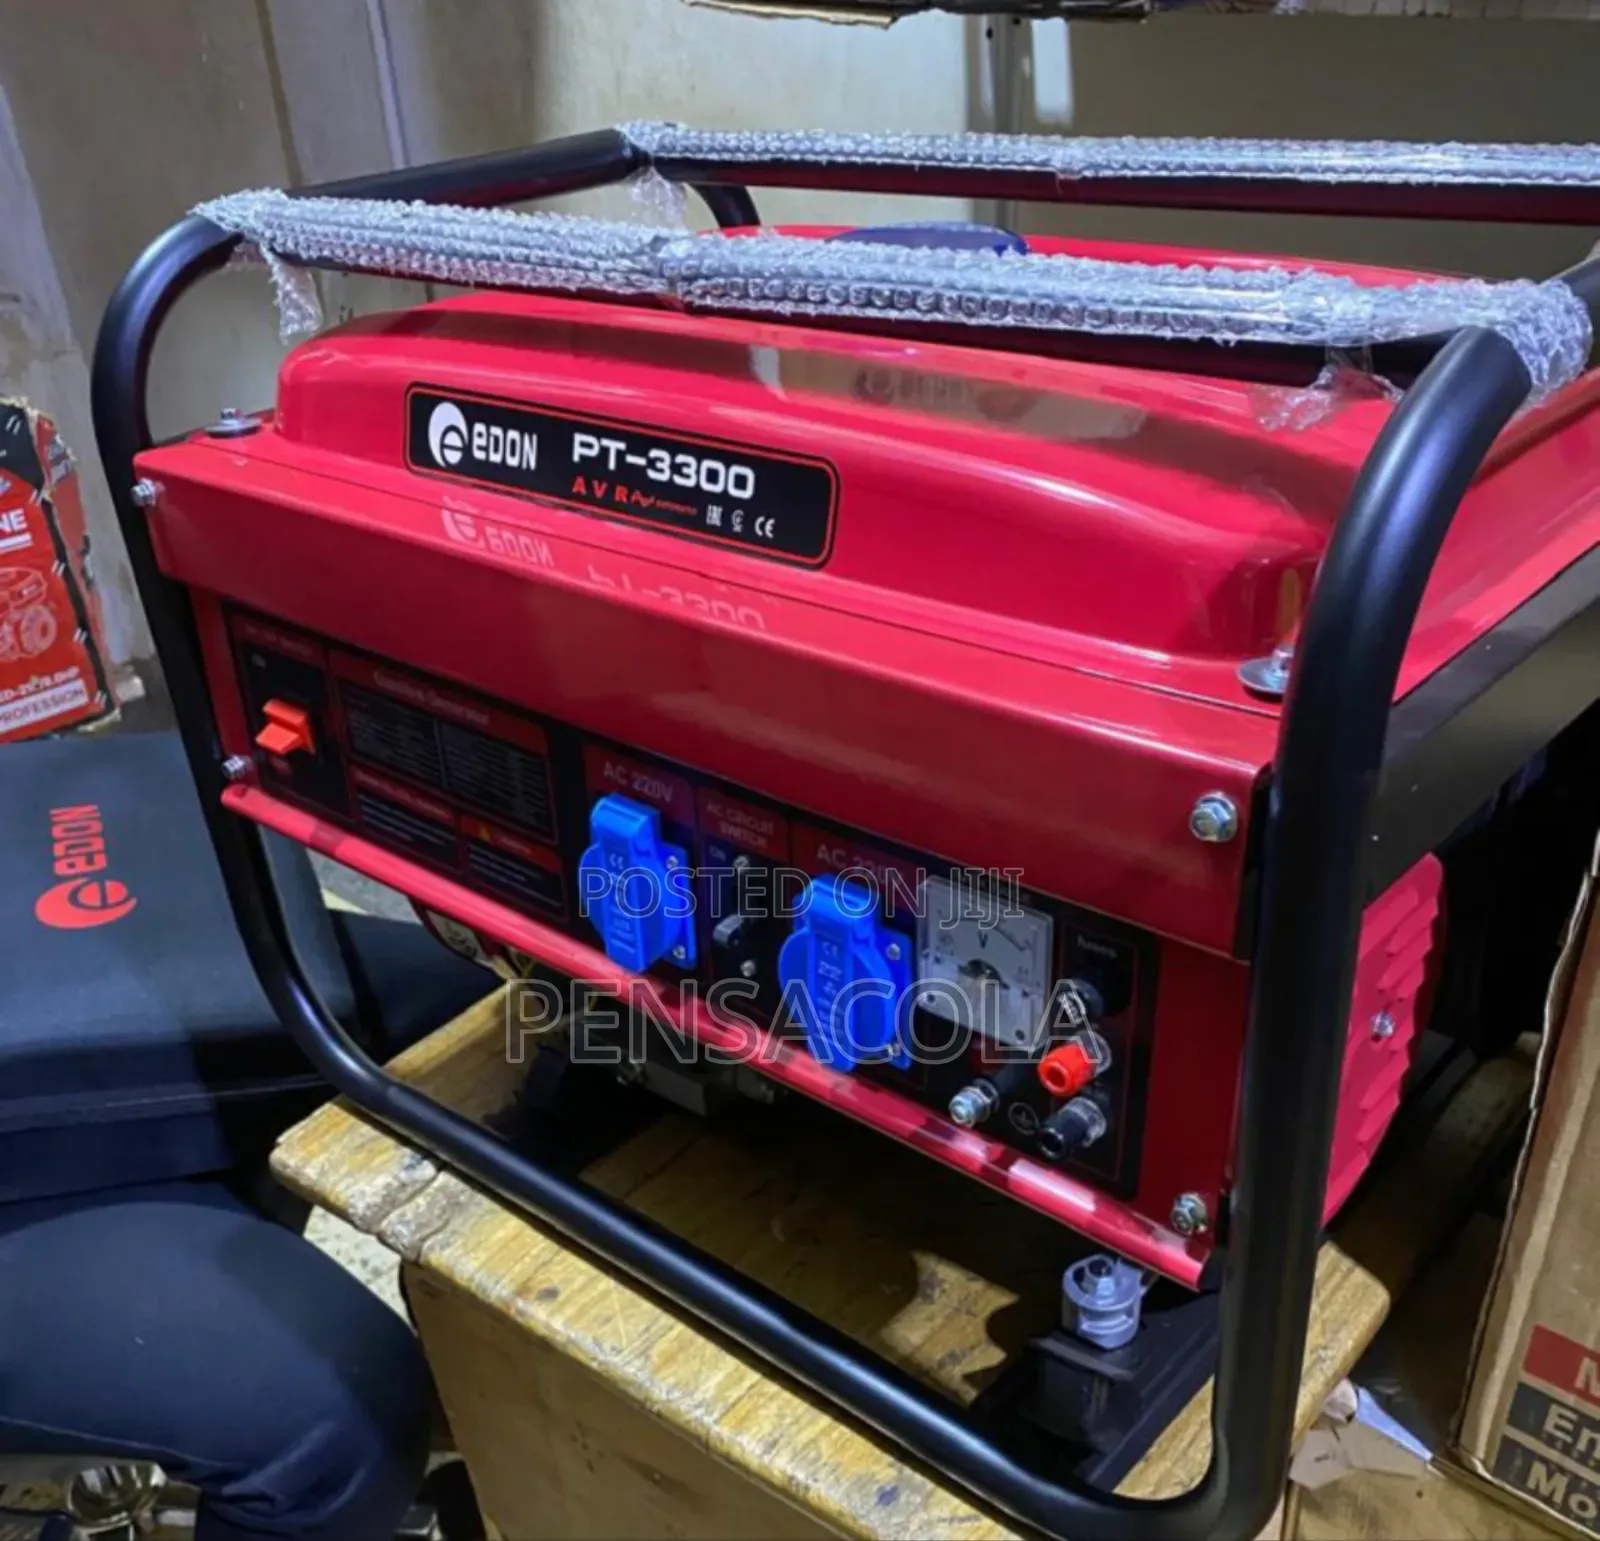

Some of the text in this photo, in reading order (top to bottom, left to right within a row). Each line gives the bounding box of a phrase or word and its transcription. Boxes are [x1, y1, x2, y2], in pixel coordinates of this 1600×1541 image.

[572, 432, 755, 499] PT-3300
[755, 516, 776, 539] CE
[604, 761, 628, 786] AC
